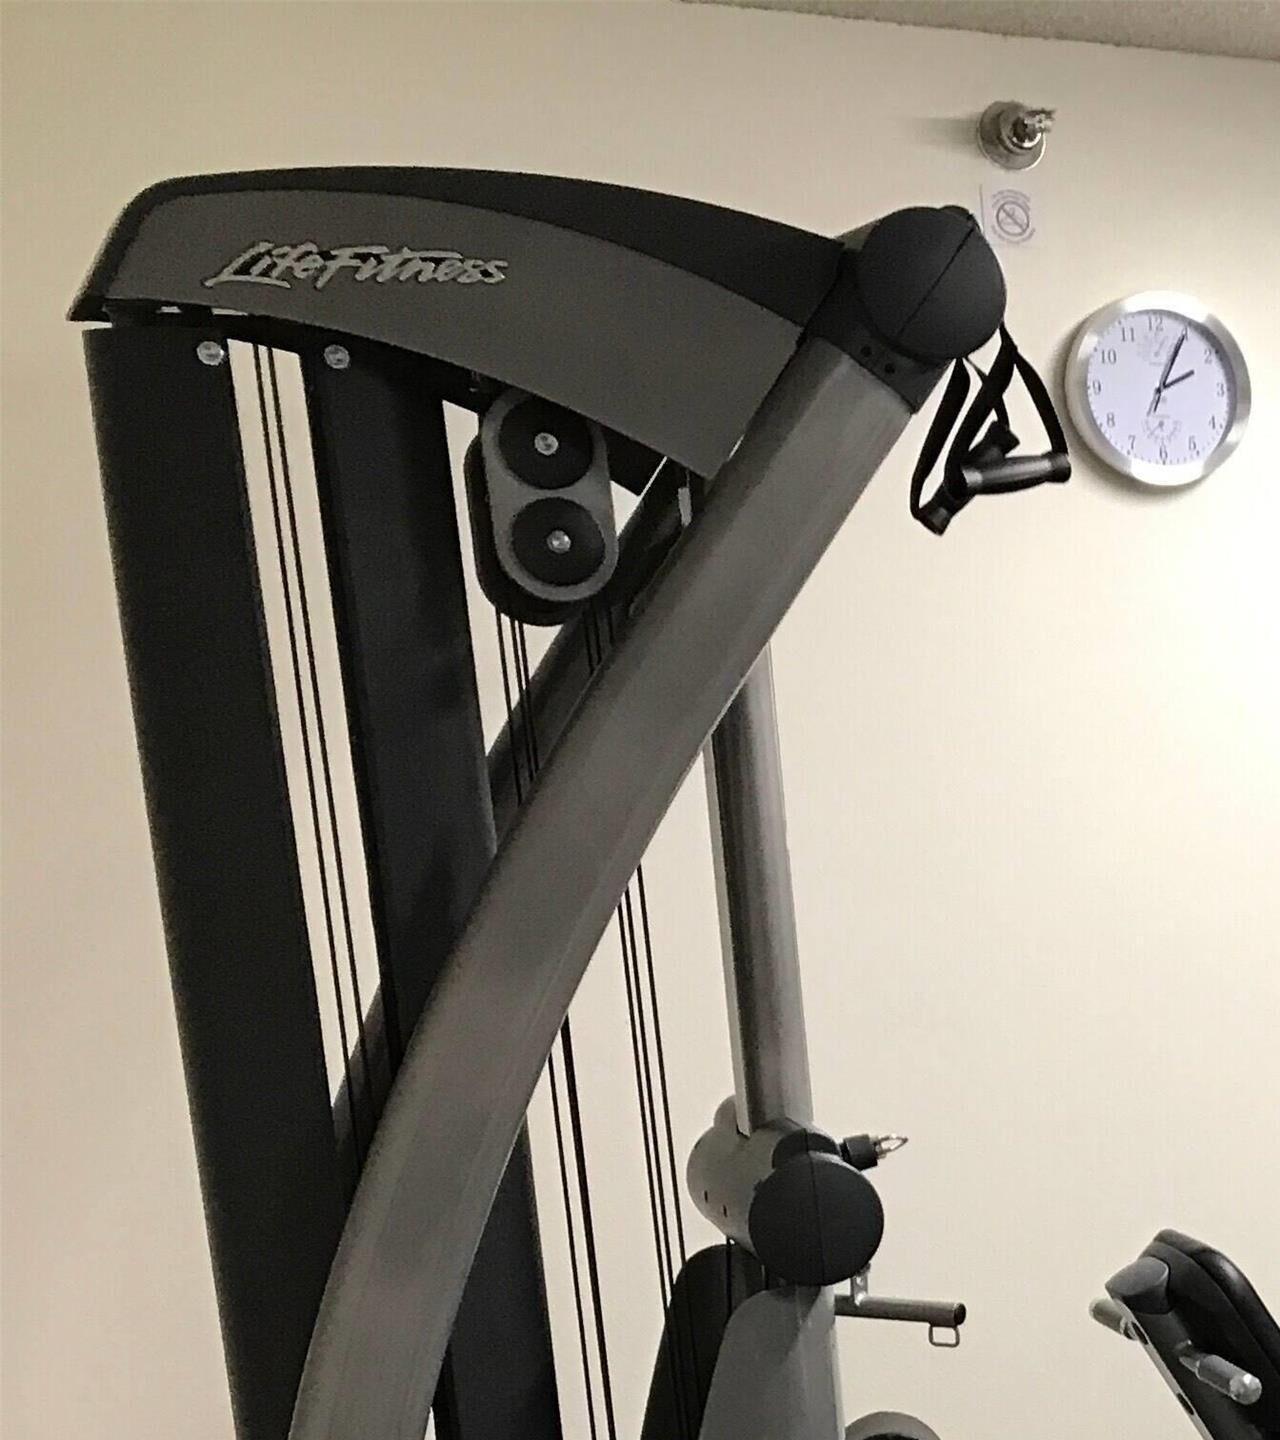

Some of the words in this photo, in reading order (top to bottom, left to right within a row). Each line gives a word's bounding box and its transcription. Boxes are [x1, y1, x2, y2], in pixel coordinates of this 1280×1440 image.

[1147, 316, 1164, 332] 12
[1121, 327, 1136, 342] 11
[1100, 350, 1117, 364] 10
[1203, 348, 1213, 363] 2
[1092, 380, 1102, 394] 9
[1216, 382, 1225, 397] 3
[1106, 413, 1116, 427] 8
[1208, 415, 1217, 430] 4
[1128, 435, 1137, 450] 7
[1188, 436, 1197, 451] 5
[1159, 444, 1168, 460] 6
